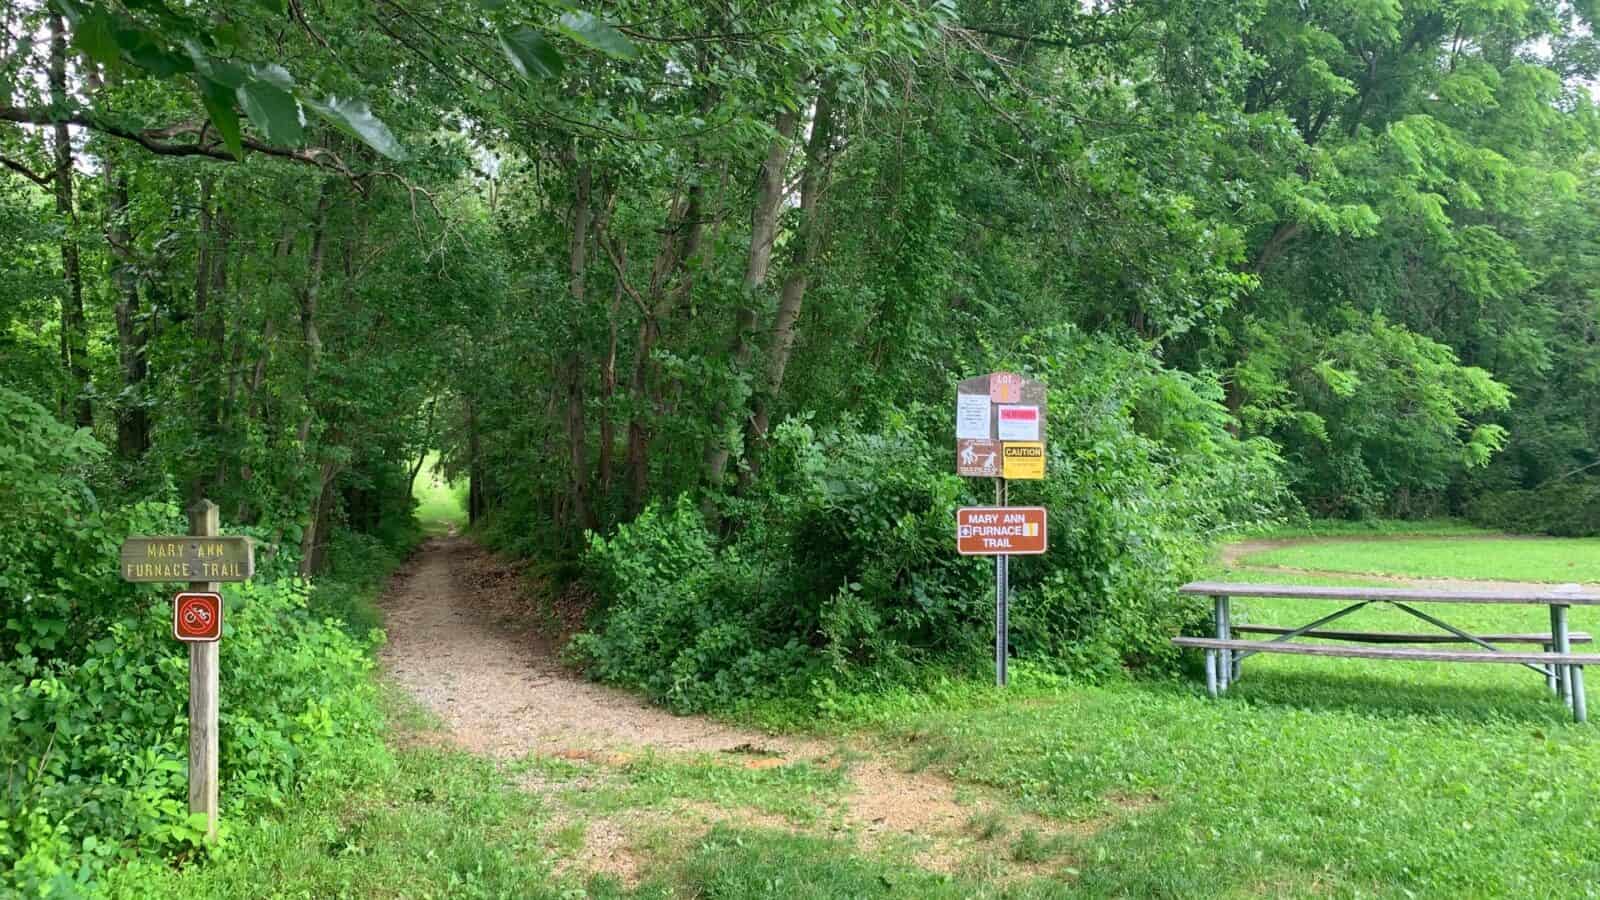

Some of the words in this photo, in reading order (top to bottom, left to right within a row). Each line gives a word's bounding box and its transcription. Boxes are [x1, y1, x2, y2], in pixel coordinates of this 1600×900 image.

[1005, 447, 1041, 457] CAUTION
[968, 514, 999, 524] MARY
[1003, 514, 1026, 524] ANN
[972, 526, 1022, 536] FURNACE
[983, 538, 1012, 548] TRAIL
[147, 543, 184, 558] MARY
[198, 543, 225, 558] ANN
[127, 563, 190, 577] FURNACE
[202, 563, 242, 577] TRAIL
